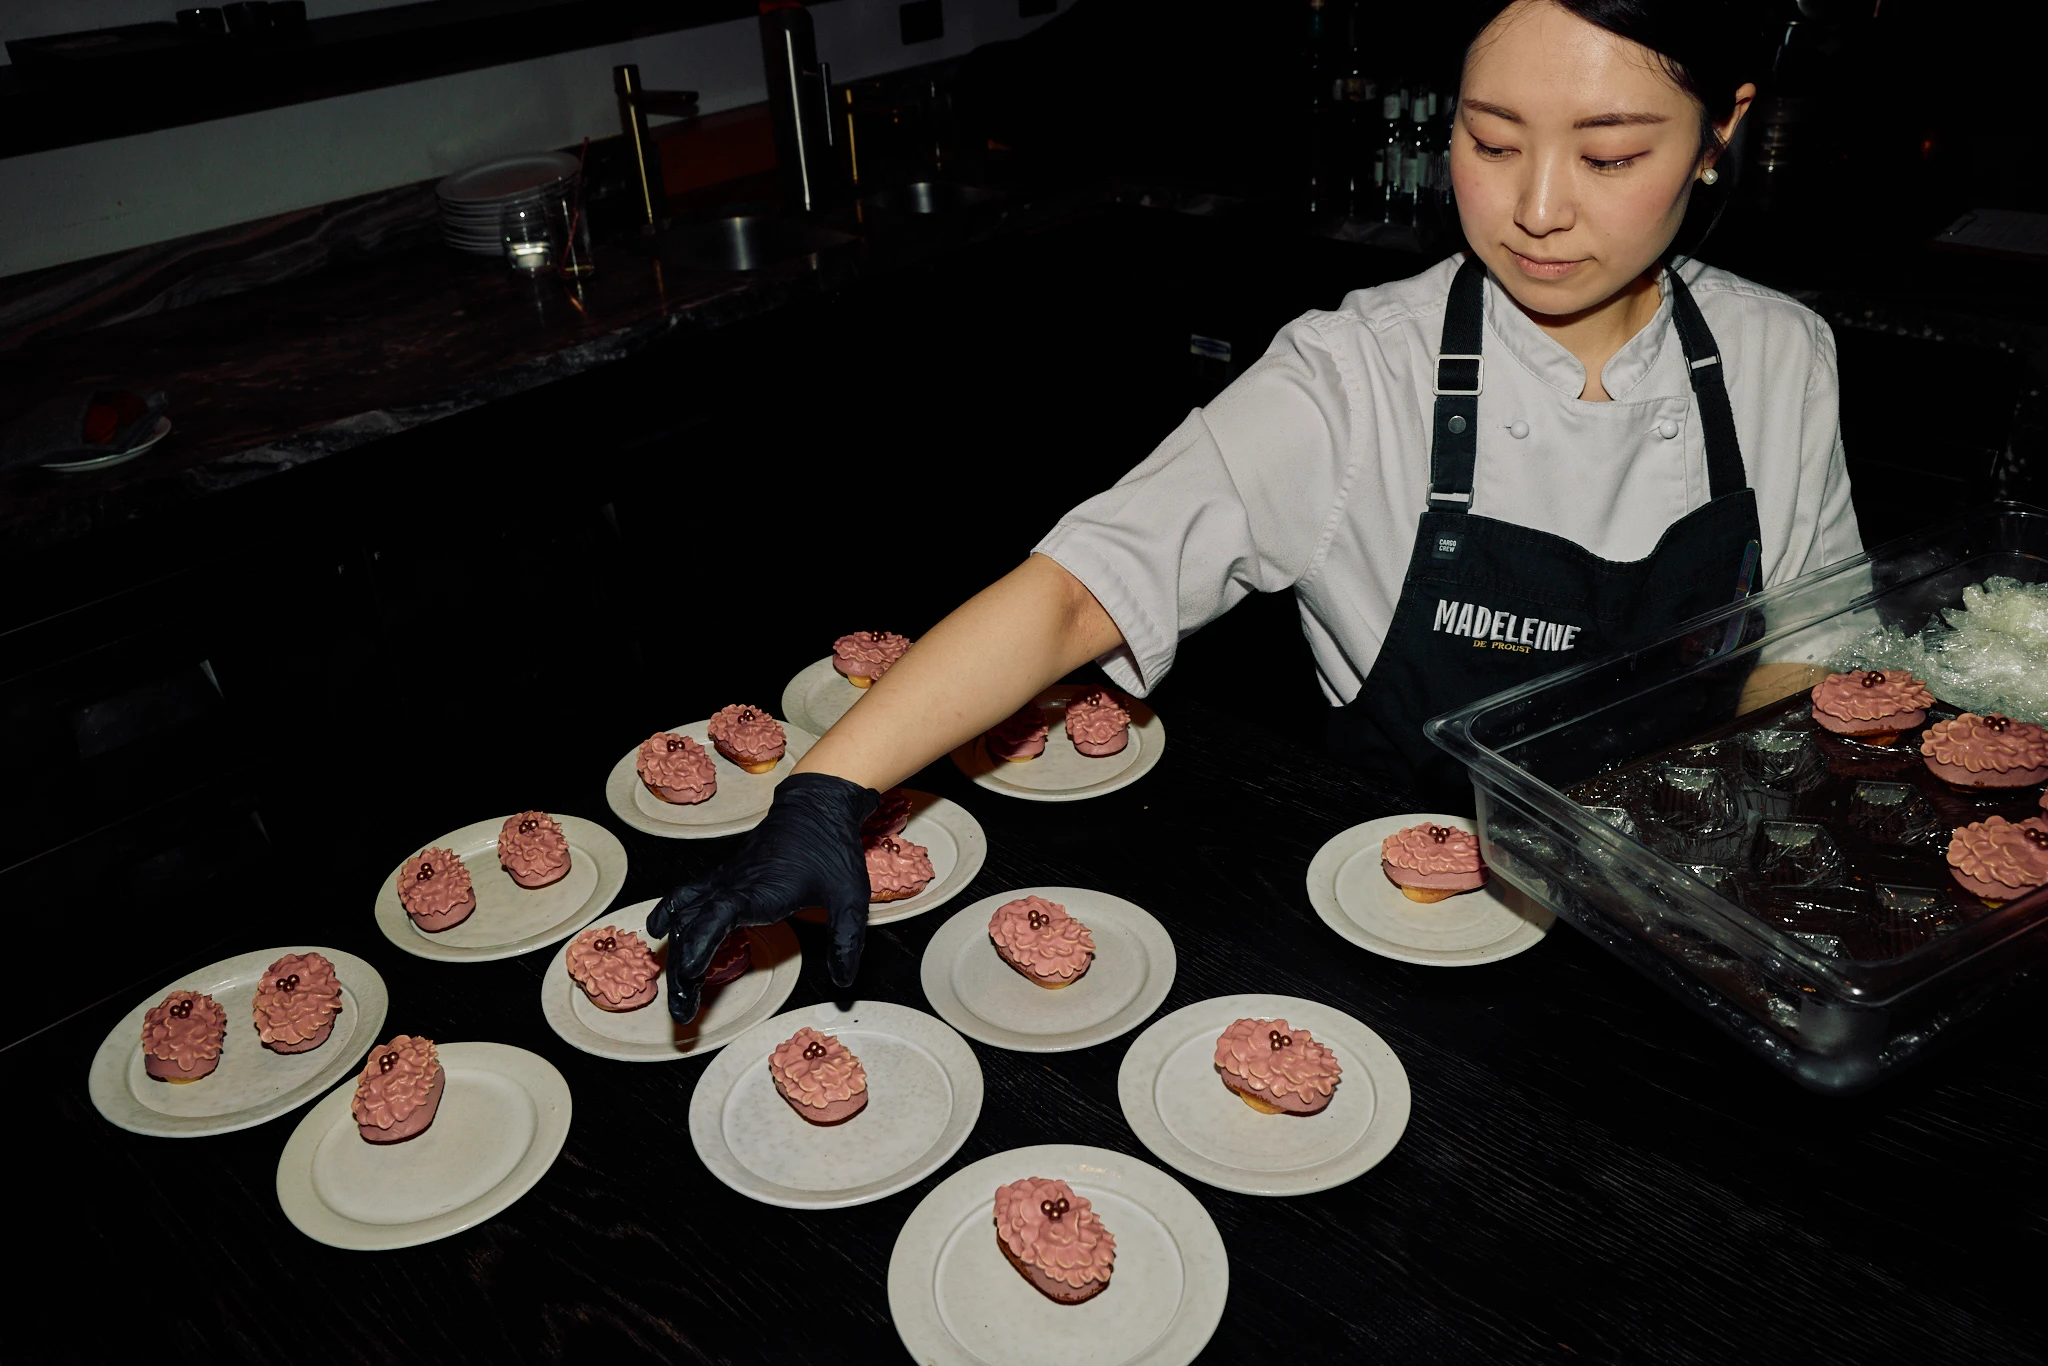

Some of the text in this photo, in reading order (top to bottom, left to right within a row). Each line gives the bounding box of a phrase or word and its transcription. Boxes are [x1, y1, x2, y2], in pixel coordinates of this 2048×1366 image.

[1439, 538, 1457, 547] CARGO
[1438, 545, 1455, 553] CREW
[1433, 599, 1582, 652] MADELEINE
[1473, 640, 1532, 653] DE PROUST
